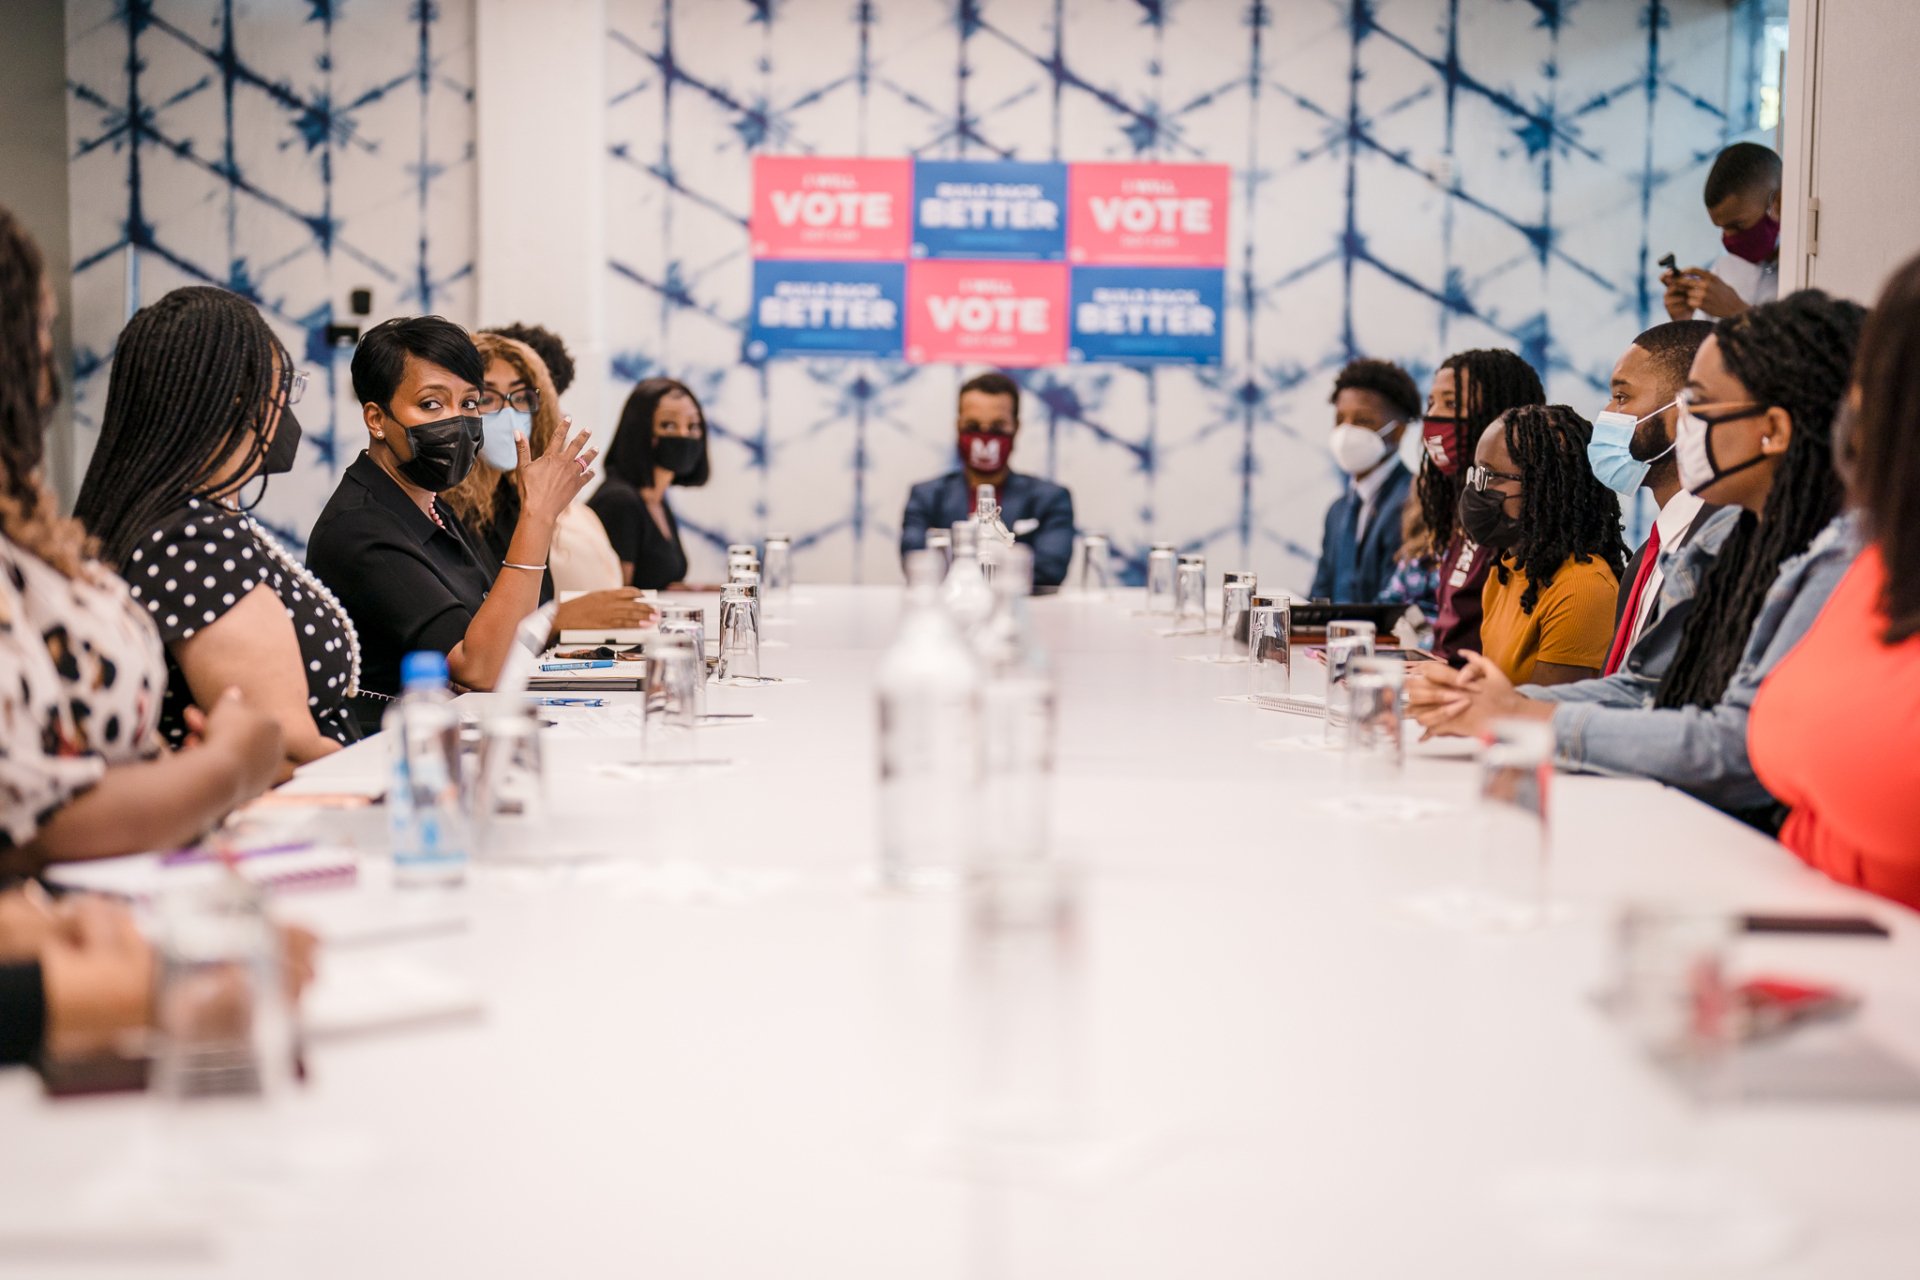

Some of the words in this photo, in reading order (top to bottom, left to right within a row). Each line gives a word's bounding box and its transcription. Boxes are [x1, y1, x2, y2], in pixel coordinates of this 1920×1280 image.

[770, 190, 893, 228] VOTE
[920, 198, 1059, 230] BETTER
[1089, 196, 1212, 234] VOTE
[759, 296, 897, 330] BETTER
[927, 295, 1049, 333] VOTE
[1077, 302, 1216, 336] BETTER
